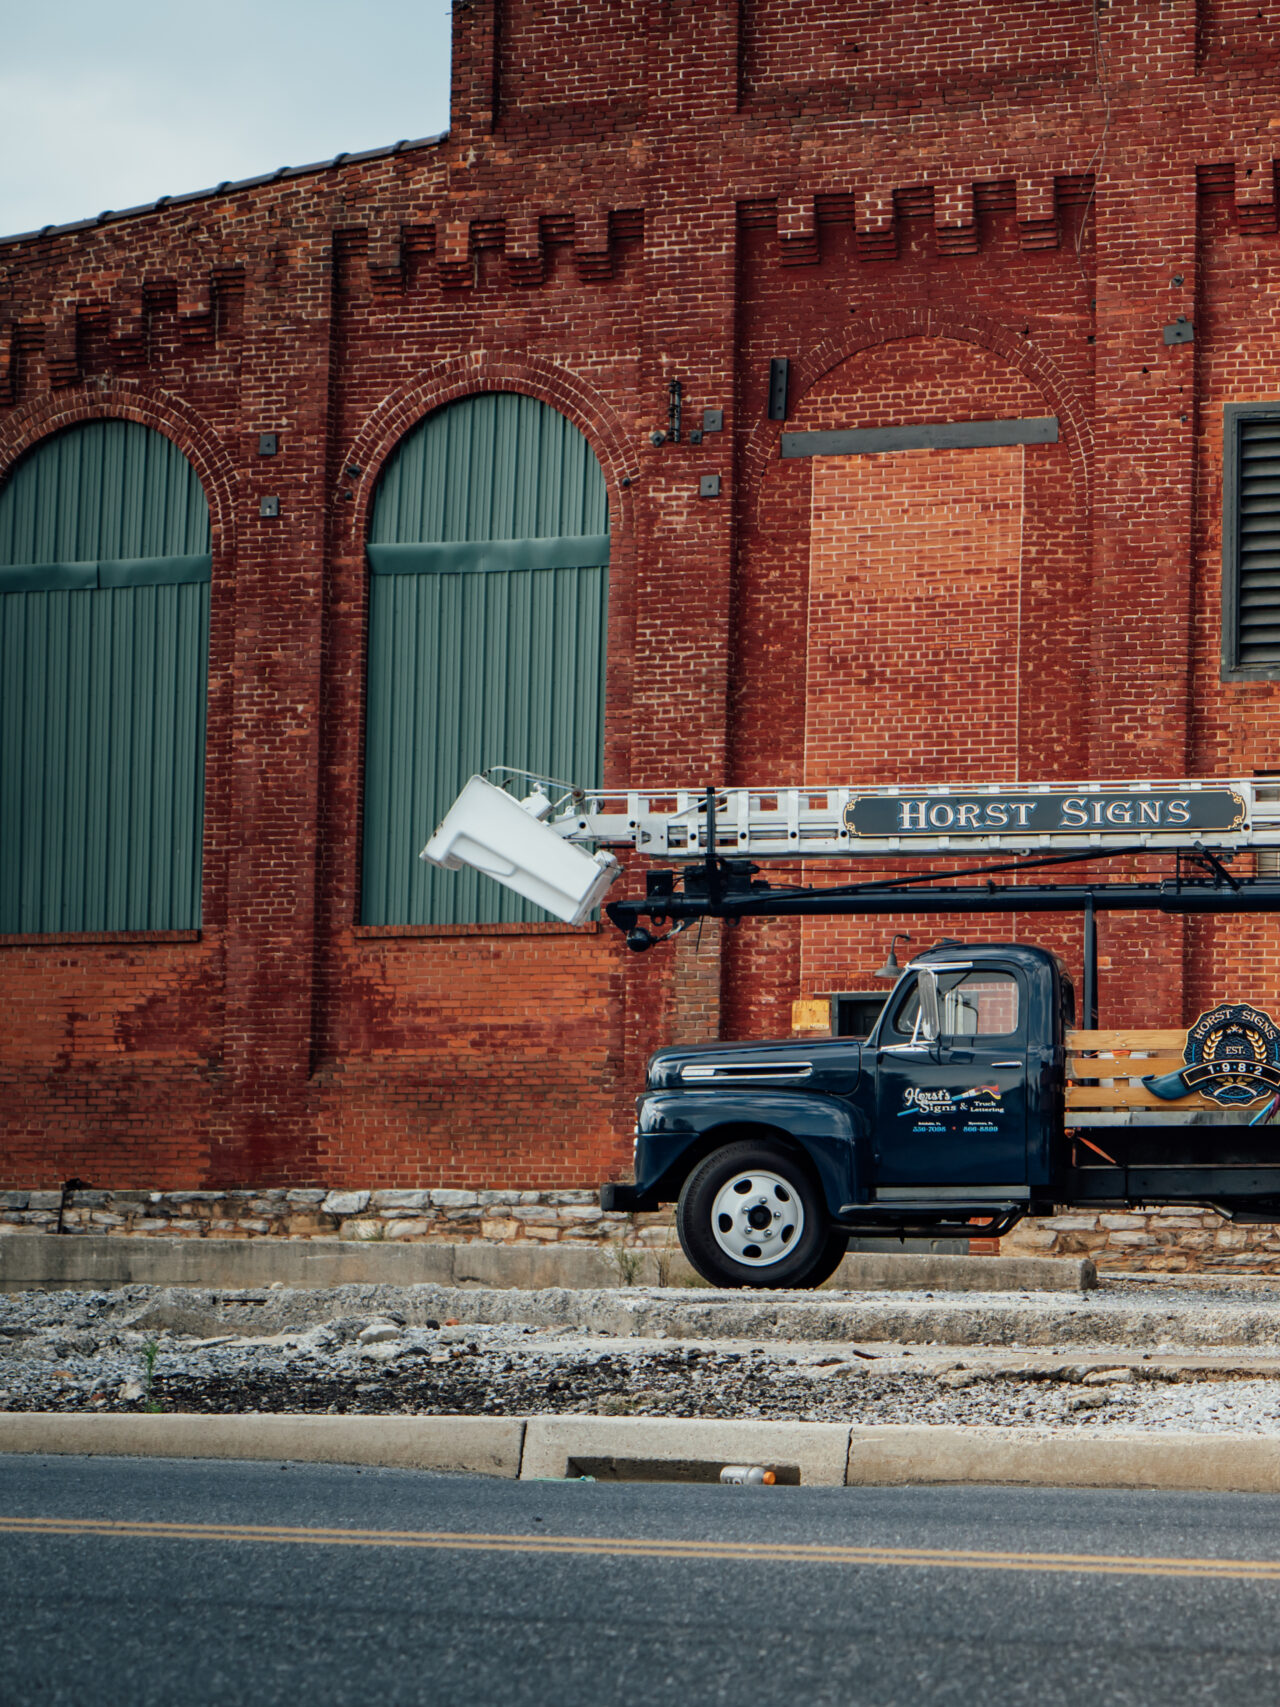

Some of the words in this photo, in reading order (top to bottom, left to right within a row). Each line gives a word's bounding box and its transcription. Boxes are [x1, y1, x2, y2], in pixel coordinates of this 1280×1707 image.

[899, 799, 1036, 830] HORST
[1059, 797, 1191, 827] SIGNS
[1193, 1009, 1234, 1040] HORST
[1241, 1010, 1277, 1040] SIGNS
[1225, 1045, 1246, 1055] EST.
[904, 1088, 951, 1106] Horst's
[919, 1101, 957, 1113] Signs
[959, 1102, 968, 1111] &
